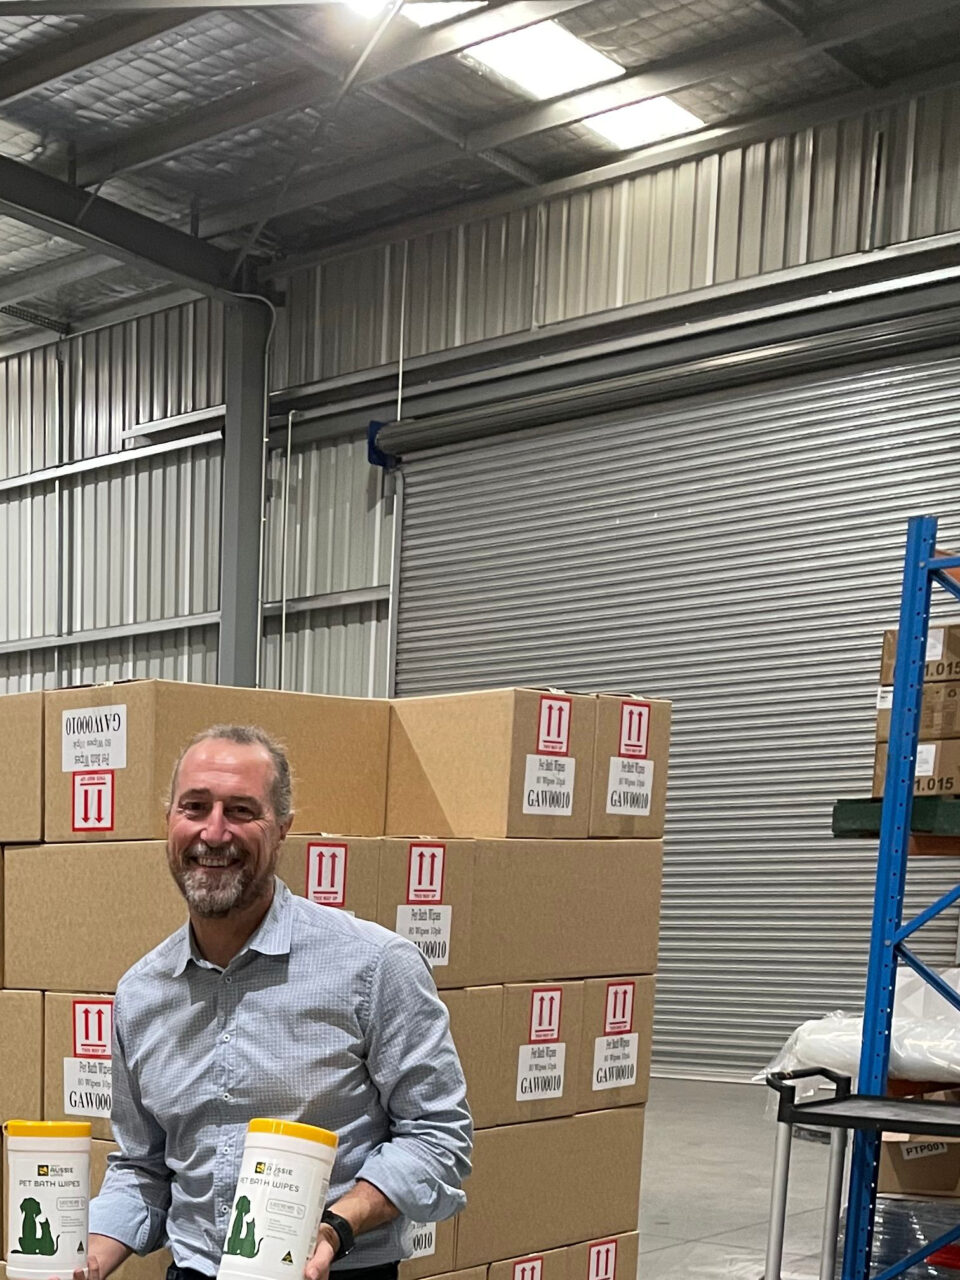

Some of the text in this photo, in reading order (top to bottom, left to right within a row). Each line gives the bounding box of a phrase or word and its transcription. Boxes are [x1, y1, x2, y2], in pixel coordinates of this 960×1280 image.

[66, 713, 121, 735] GAW00010
[74, 751, 110, 767] Pet Bath Wipes
[545, 759, 553, 771] Bath
[554, 760, 565, 774] Wipes
[527, 789, 570, 808] GAW00010
[610, 790, 649, 809] GAW00010
[418, 908, 427, 921] Bath
[428, 909, 441, 924] Wipes
[414, 941, 447, 959] 00010
[537, 1047, 545, 1058] Bath
[546, 1046, 557, 1060] Wipes
[88, 1061, 97, 1073] Bath
[98, 1062, 112, 1076] Wipe
[596, 1063, 634, 1084] GAW00010
[521, 1074, 561, 1094] GAW00010
[70, 1091, 112, 1111] GAW000
[906, 1142, 945, 1156] PTP001
[272, 1182, 300, 1193] WIPES
[413, 1232, 432, 1251] 0010
